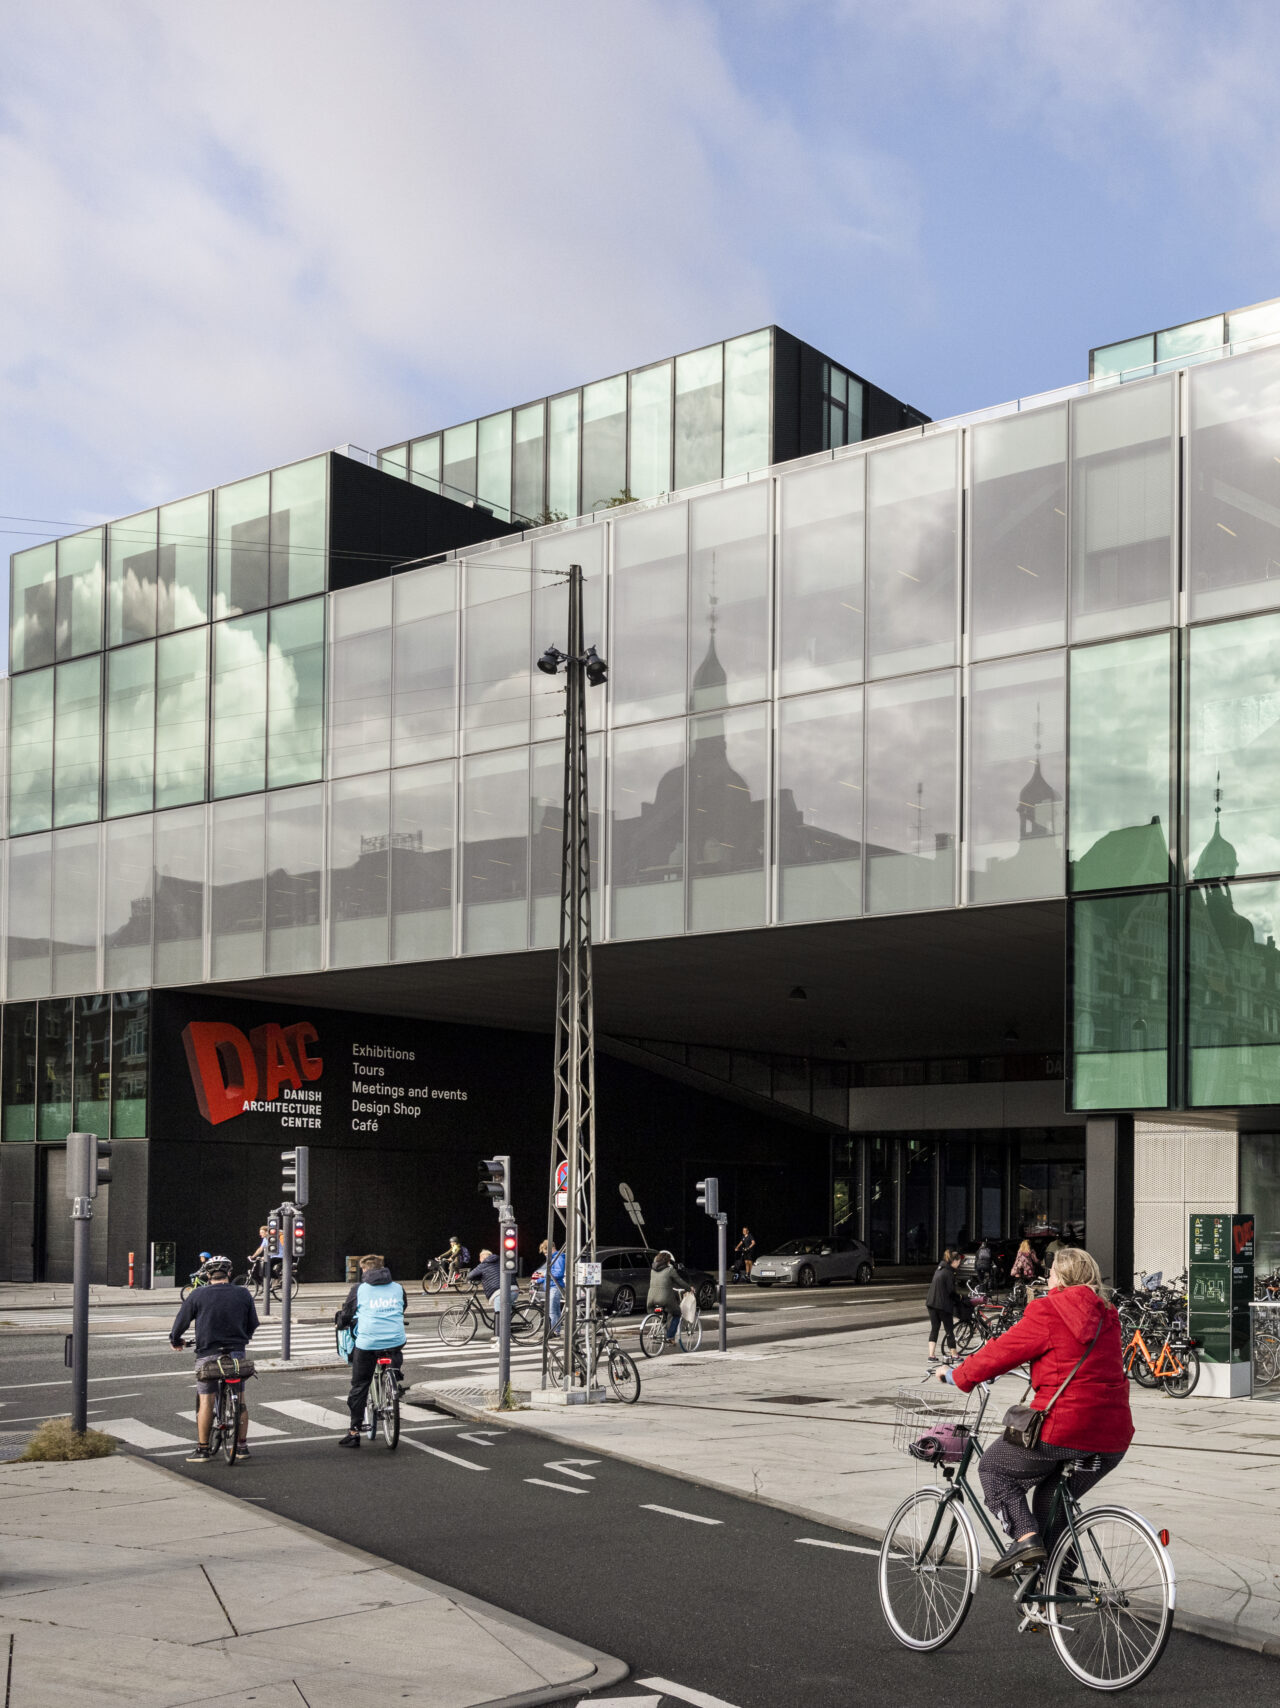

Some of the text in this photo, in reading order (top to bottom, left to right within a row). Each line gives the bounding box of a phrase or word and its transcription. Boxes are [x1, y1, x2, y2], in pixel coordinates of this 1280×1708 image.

[352, 1044, 416, 1061] Exhibitions
[181, 1021, 323, 1126] DAC
[352, 1062, 385, 1077] Tours
[284, 1089, 322, 1102] DANISH
[352, 1081, 468, 1101] Meetings and events
[242, 1100, 322, 1115] ARCHITECTURE
[352, 1100, 421, 1118] Design Shop
[281, 1116, 322, 1129] CENTER
[352, 1119, 379, 1133] Café
